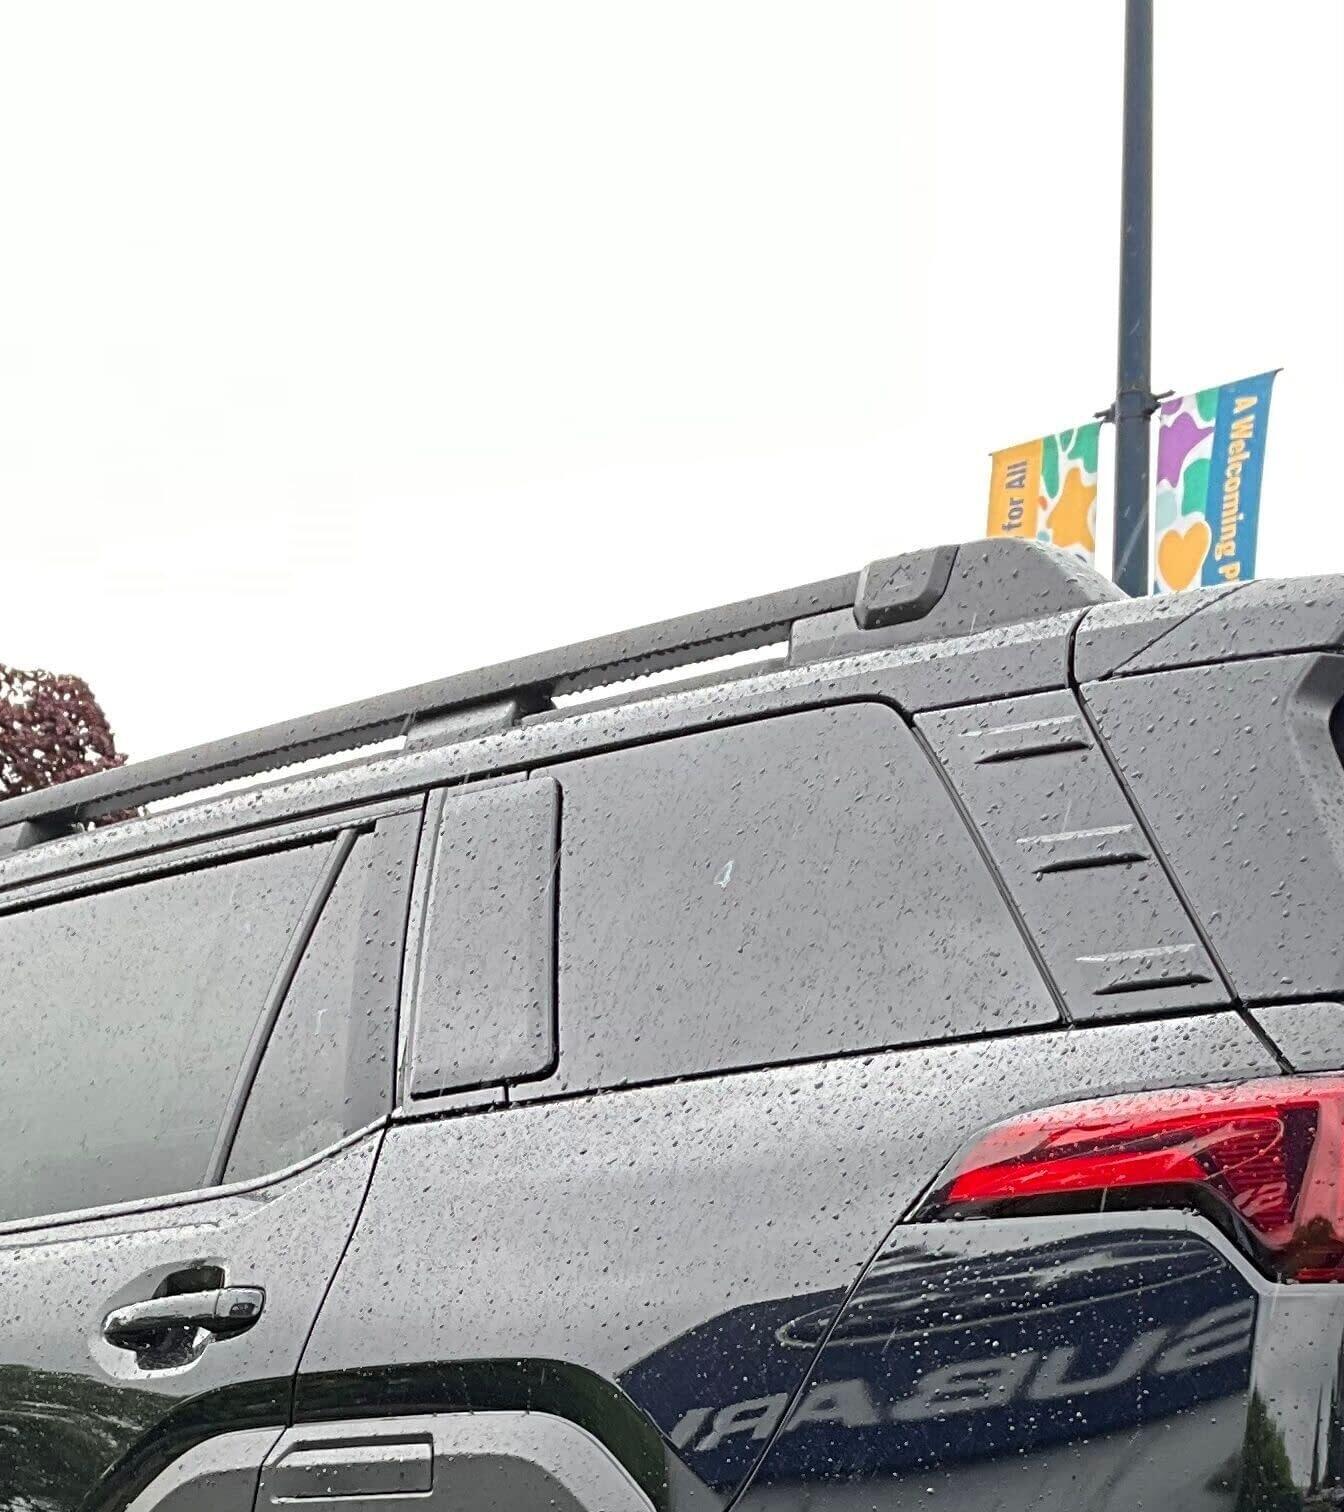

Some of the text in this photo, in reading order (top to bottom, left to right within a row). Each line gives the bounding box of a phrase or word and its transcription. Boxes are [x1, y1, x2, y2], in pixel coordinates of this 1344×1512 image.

[1001, 460, 1028, 531] for All
[1214, 414, 1256, 561] Welcoming
[1219, 561, 1240, 582] P
